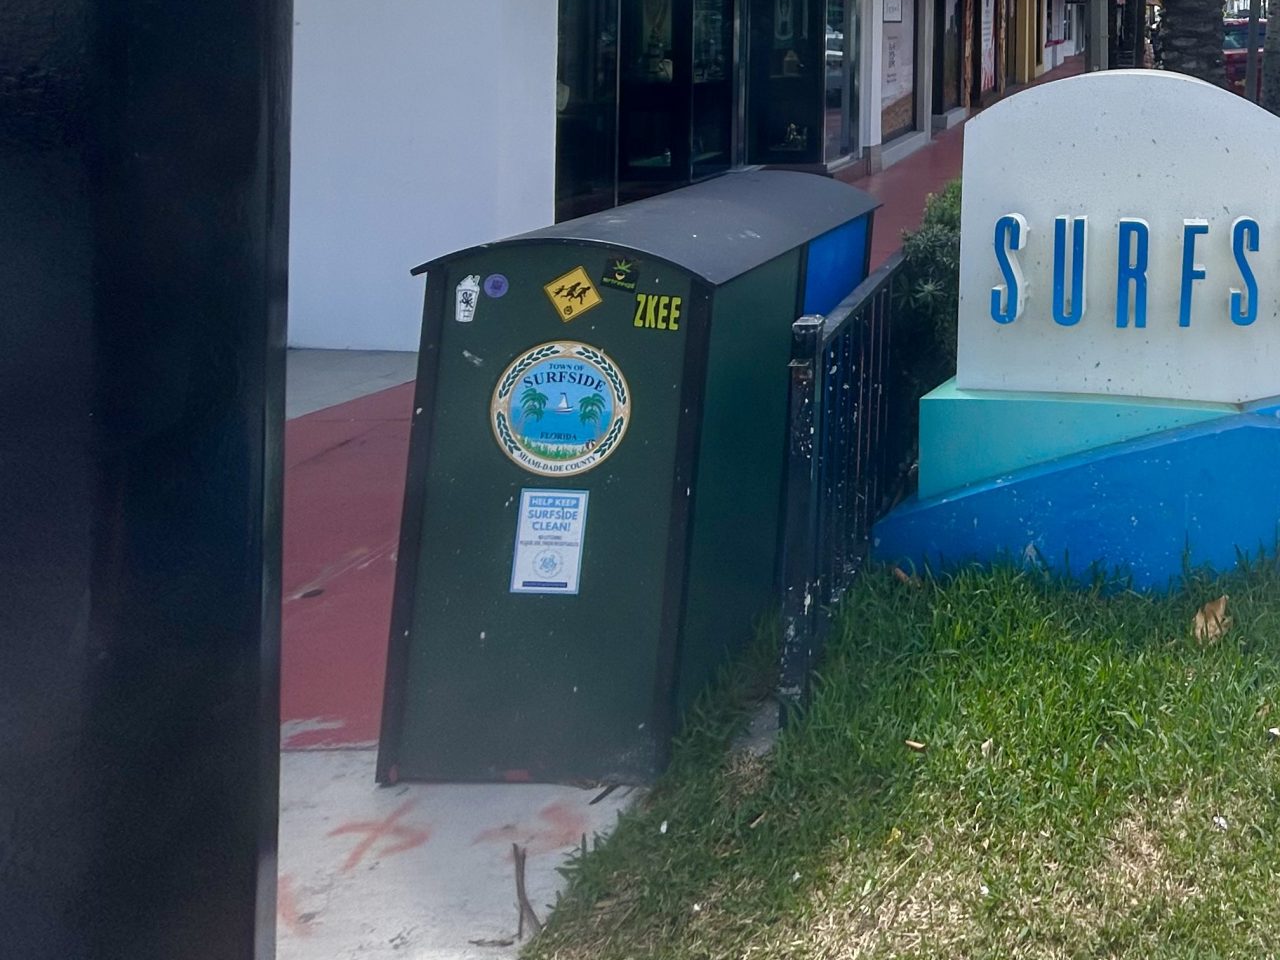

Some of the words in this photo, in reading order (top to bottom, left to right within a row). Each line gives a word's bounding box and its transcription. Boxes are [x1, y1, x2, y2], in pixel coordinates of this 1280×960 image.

[633, 293, 682, 331] ZKEE
[549, 362, 572, 371] TOWN
[574, 364, 585, 372] OF
[523, 371, 606, 393] SURFSIDE
[540, 432, 577, 441] FLORIDA
[518, 451, 564, 472] MIAMI-DADE
[565, 455, 597, 472] COUNTY
[530, 497, 554, 506] HELP
[528, 510, 578, 520] SURFSIDE
[532, 522, 571, 532] CLEAN!
